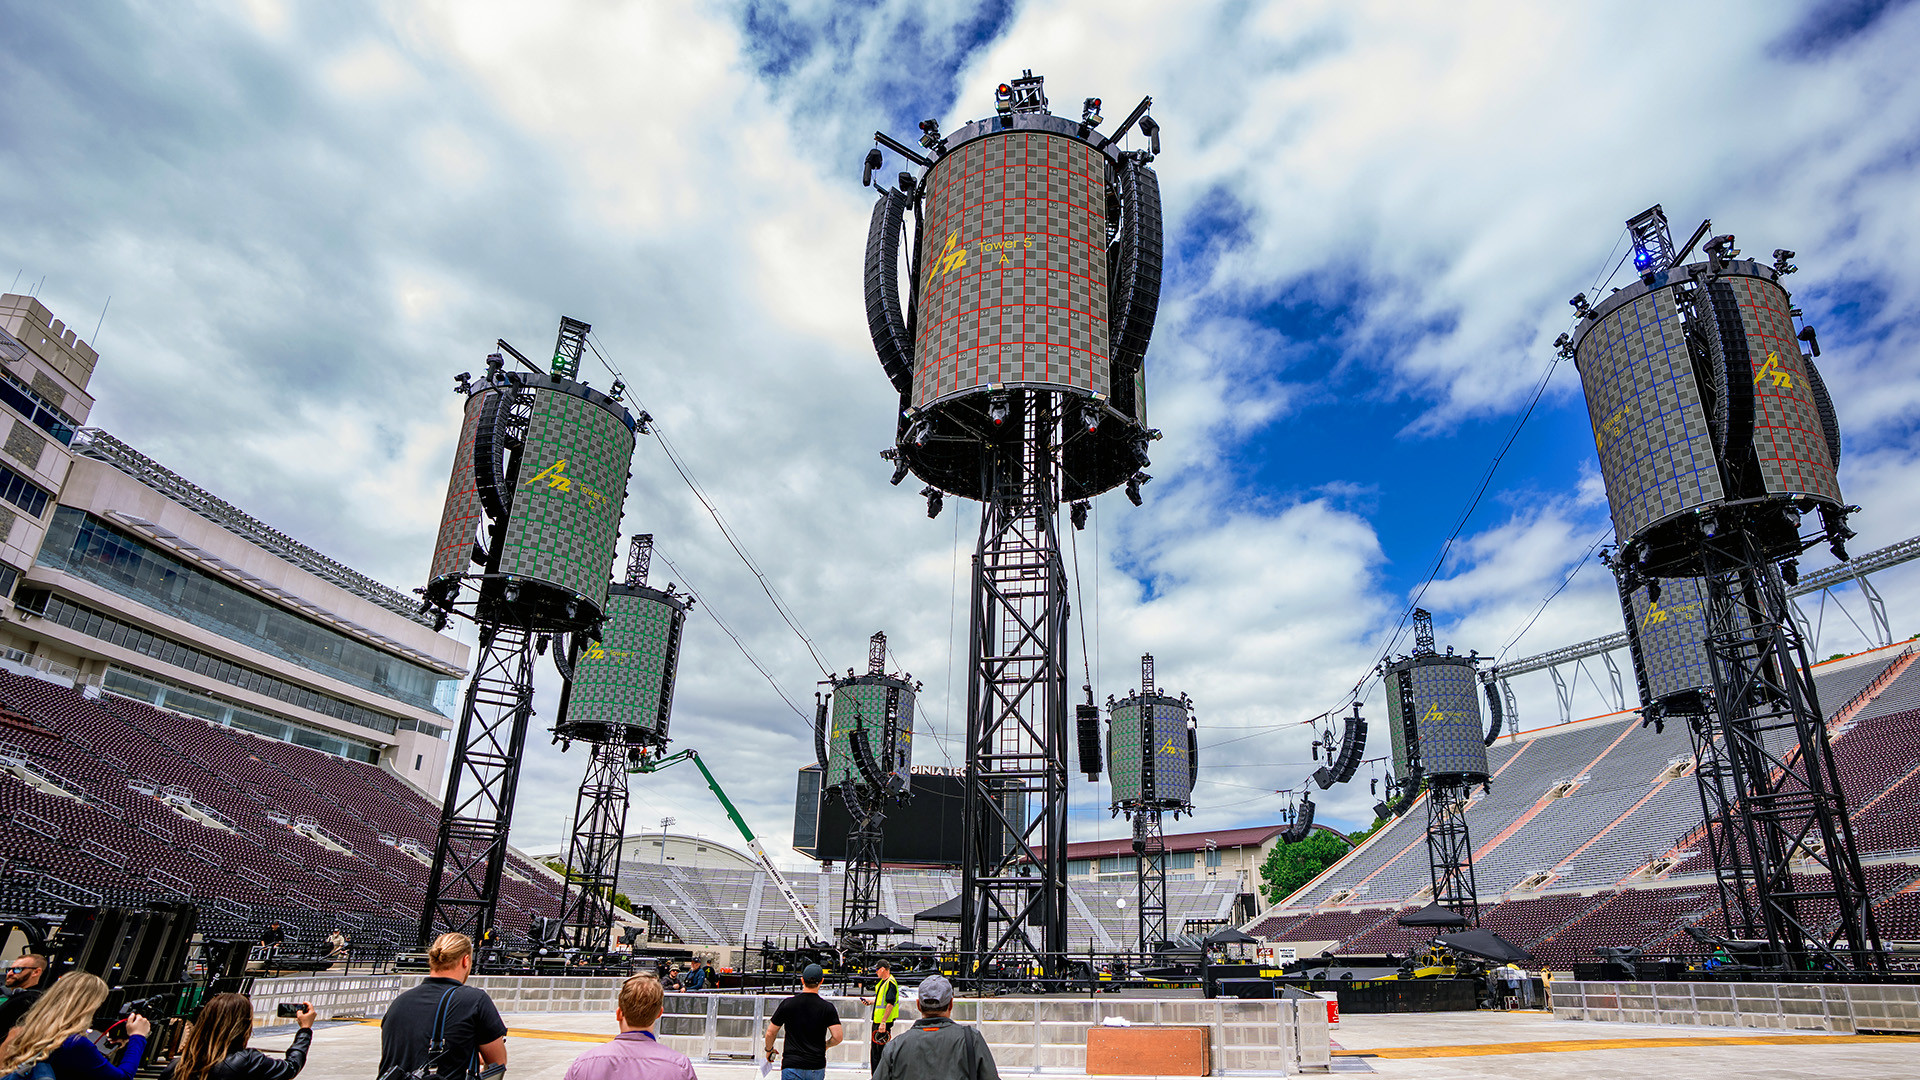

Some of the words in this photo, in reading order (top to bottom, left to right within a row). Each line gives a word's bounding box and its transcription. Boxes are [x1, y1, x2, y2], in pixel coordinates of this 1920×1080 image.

[978, 240, 1019, 252] Tower
[1024, 238, 1032, 248] 5
[998, 254, 1010, 264] A
[1603, 411, 1622, 432] Tower
[1624, 405, 1630, 413] 4
[1614, 426, 1620, 437] B
[579, 482, 601, 500] Tower
[588, 500, 595, 509] C
[1672, 604, 1695, 613] Tower
[910, 765, 945, 776] GINIA
[947, 767, 966, 777] TEC
[784, 890, 795, 899] JLG
[793, 901, 807, 917] ULTRA
